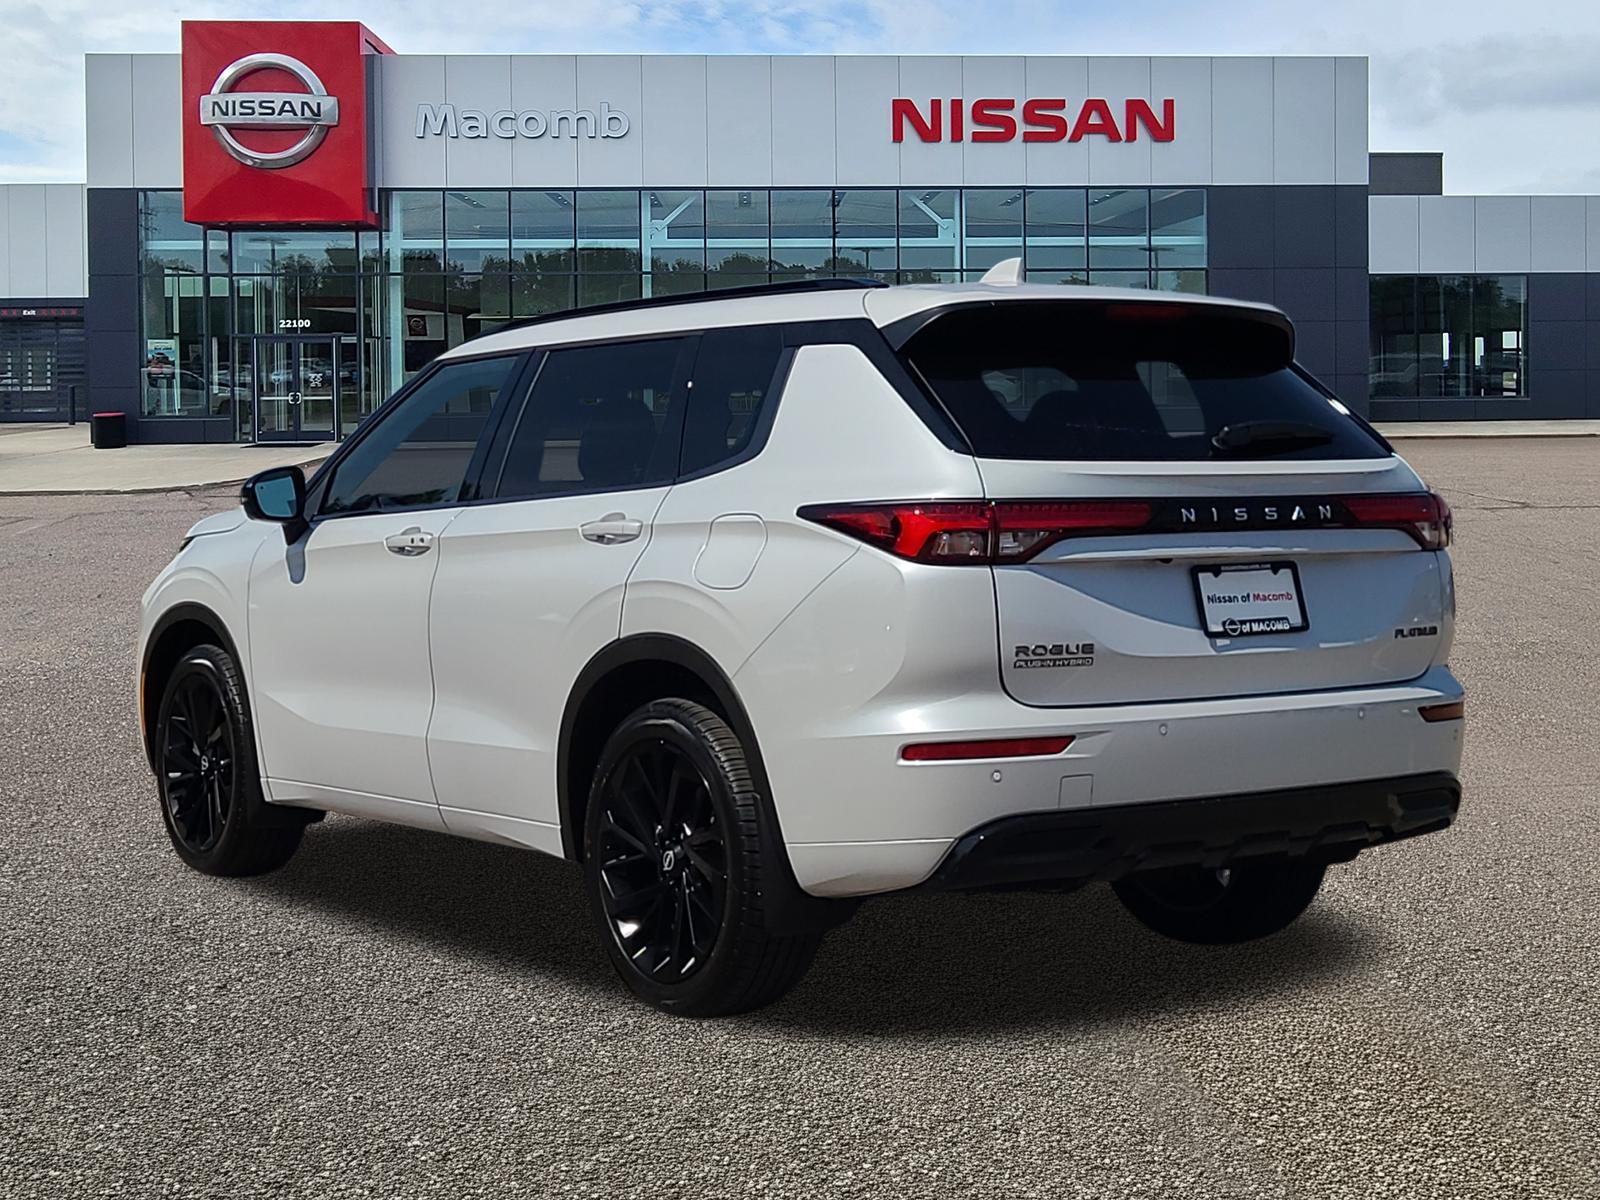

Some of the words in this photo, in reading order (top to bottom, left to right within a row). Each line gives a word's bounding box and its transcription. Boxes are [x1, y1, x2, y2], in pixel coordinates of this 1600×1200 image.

[211, 100, 322, 118] NISSAN
[415, 102, 630, 139] Macomb
[892, 98, 1176, 143] NISSAN
[279, 319, 311, 328] 22100
[1180, 504, 1332, 523] NISSAN
[1207, 593, 1240, 605] Nissan
[1240, 592, 1251, 603] of
[1252, 592, 1293, 602] Macomb
[1241, 622, 1251, 633] of
[1251, 619, 1291, 632] MACOMB
[1015, 643, 1095, 657] ROGUE
